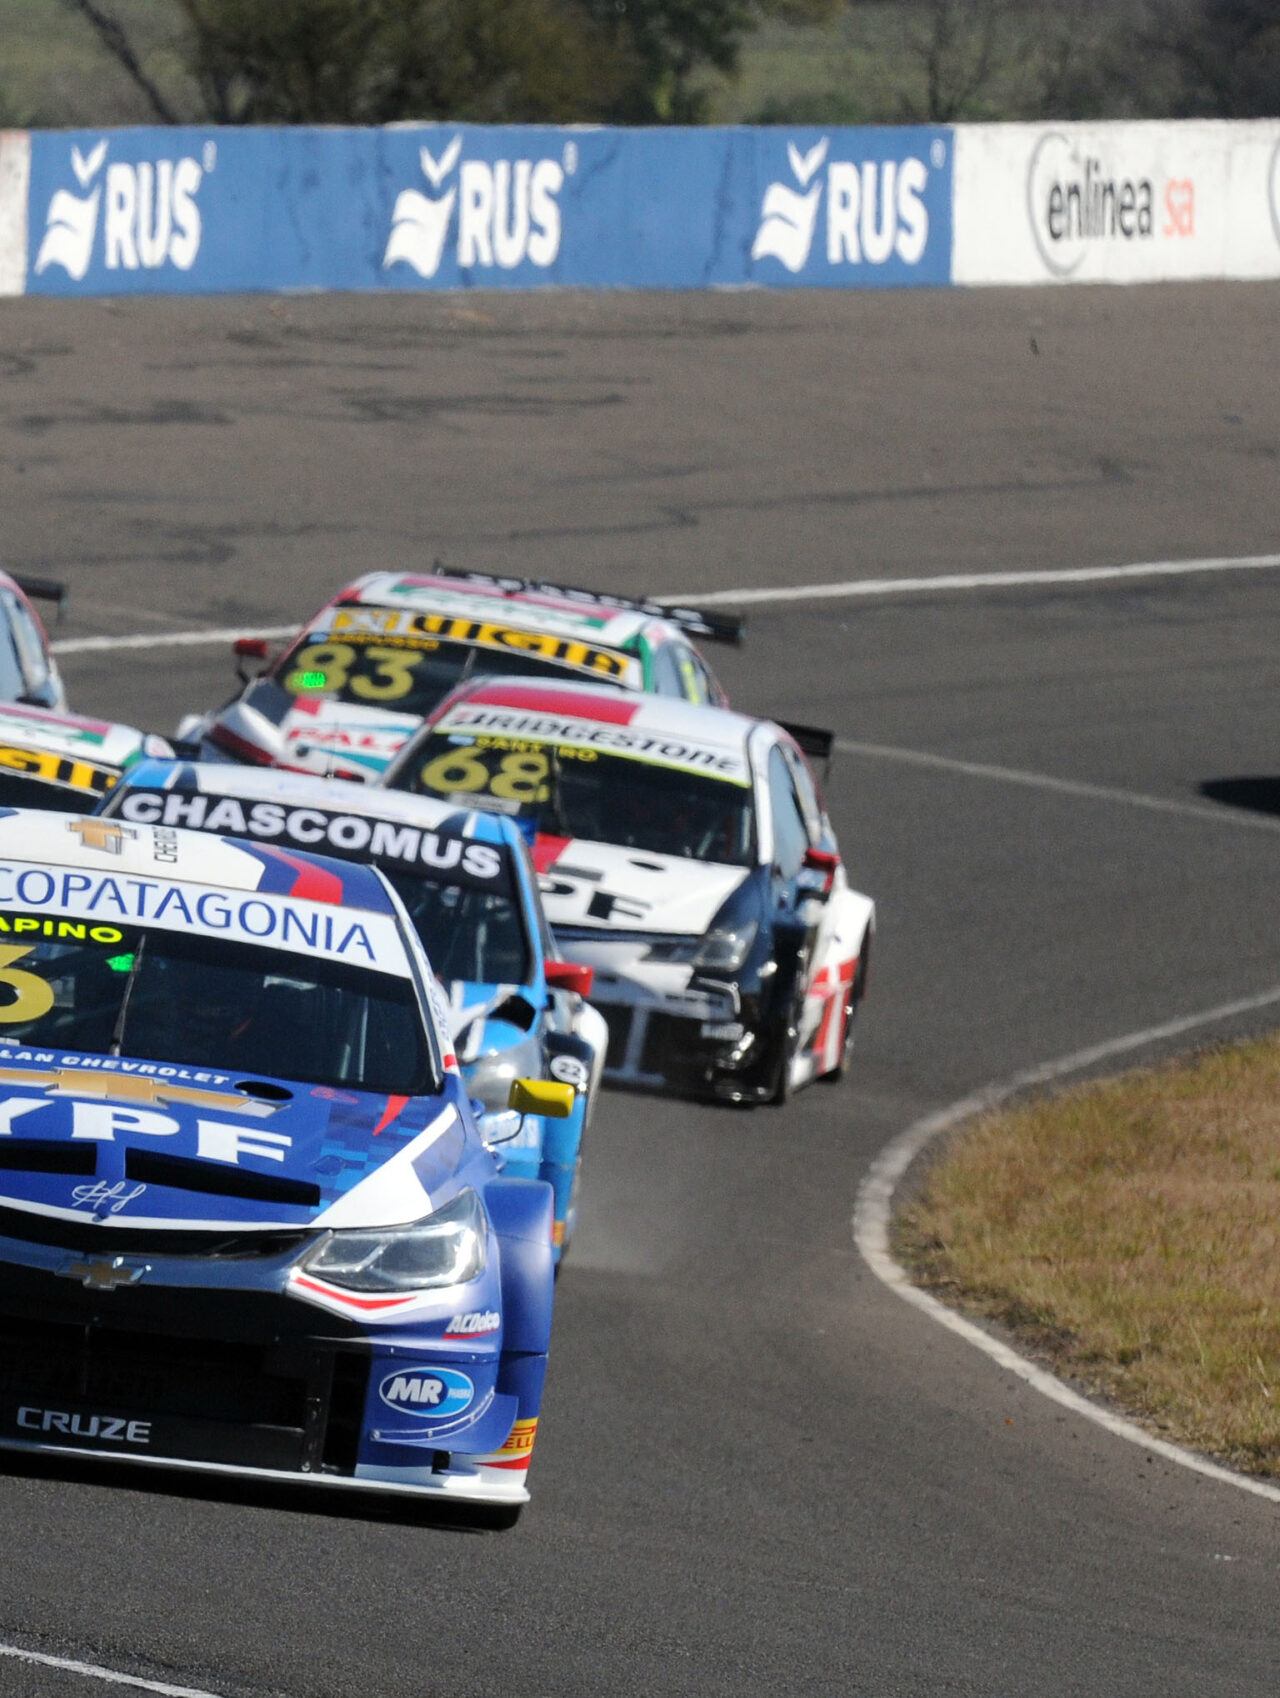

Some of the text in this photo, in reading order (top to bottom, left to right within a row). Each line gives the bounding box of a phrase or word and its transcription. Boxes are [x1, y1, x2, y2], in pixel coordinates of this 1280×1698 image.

[105, 156, 202, 270] RUS
[457, 158, 564, 269] RUS
[828, 156, 929, 265] RUS
[1048, 156, 1195, 240] enlinea sa
[284, 643, 423, 700] 83
[450, 710, 740, 771] BRIDGESTONE
[422, 746, 551, 803] 68
[120, 792, 502, 880] CHASCOMUS
[61, 1055, 230, 1085] CHEVROLET
[559, 1062, 582, 1076] 22
[445, 1309, 500, 1333] ACDelco
[386, 1376, 443, 1404] MR
[16, 1406, 152, 1443] CRUZE
